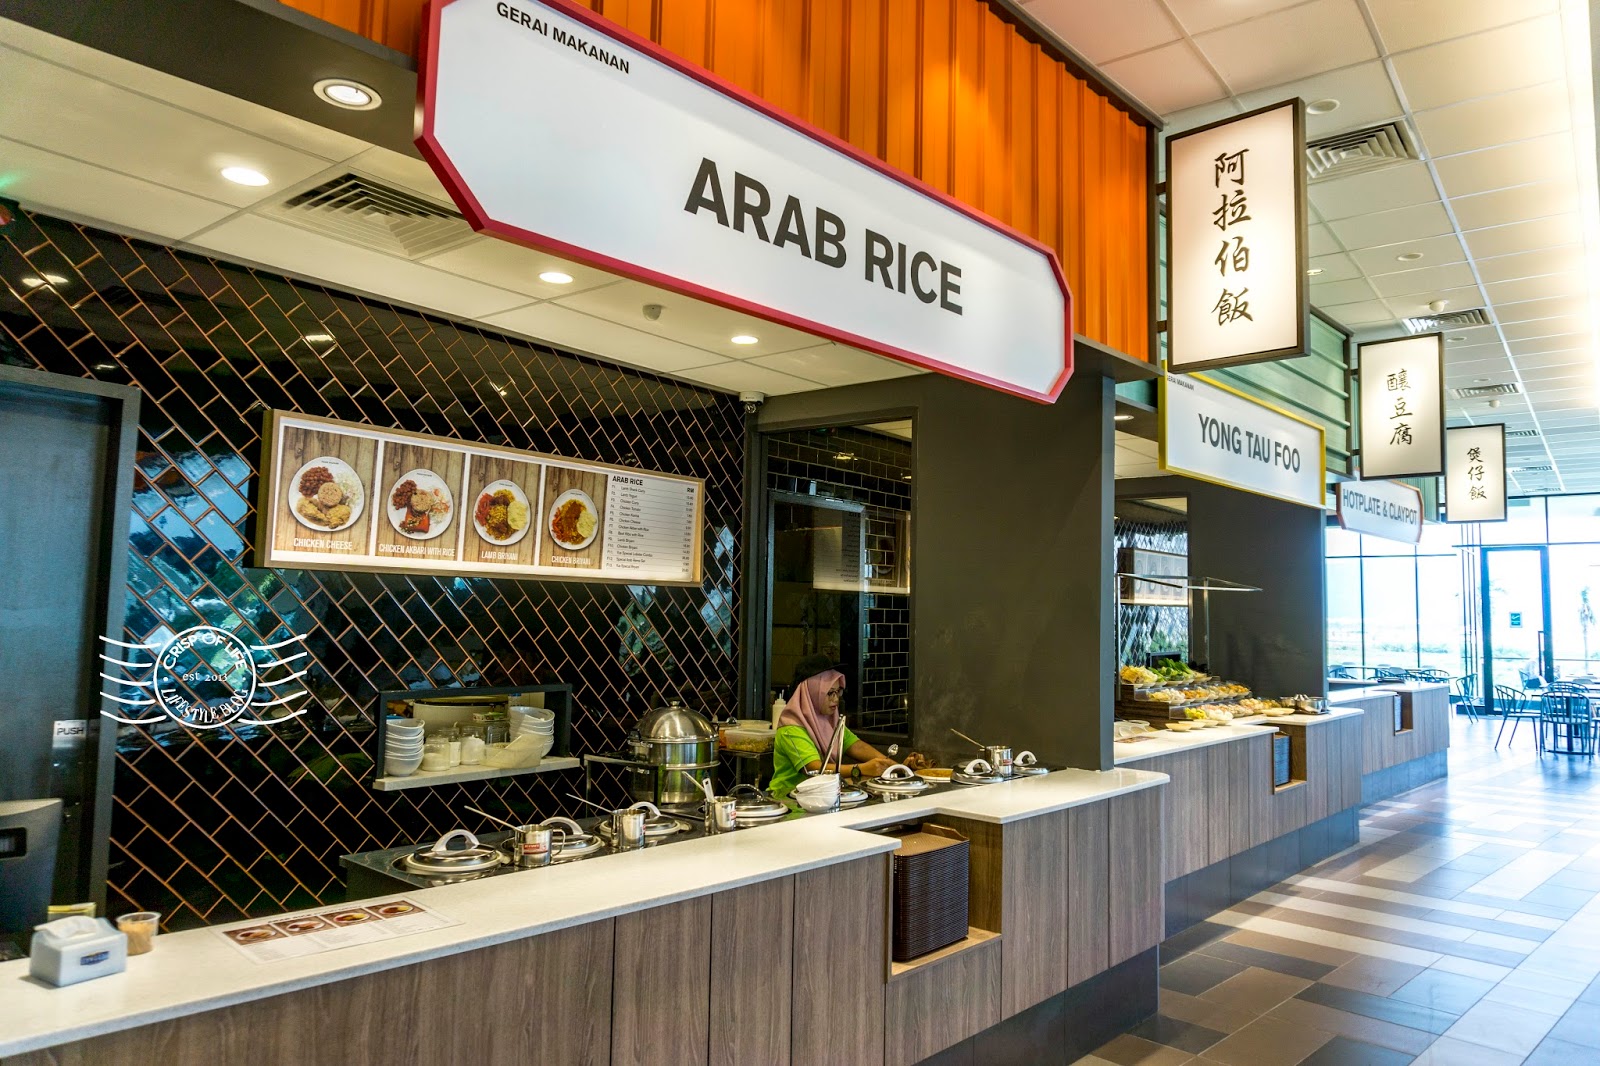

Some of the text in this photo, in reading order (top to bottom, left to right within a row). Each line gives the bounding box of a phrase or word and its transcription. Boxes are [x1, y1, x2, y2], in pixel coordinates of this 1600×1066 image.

[496, 1, 630, 74] GERAI MAKANAN
[684, 157, 963, 316] ARAB RICE
[1212, 148, 1253, 326] 阿拉伯飯
[1198, 413, 1301, 474] YONG TAU FOO
[612, 476, 644, 486] ARAB RICE
[1343, 488, 1417, 526] HOTPLATE & CLAYPOT
[293, 537, 353, 550] CHICKEN CHEESE
[378, 543, 405, 553] CHICKEN
[427, 547, 442, 556] WITH
[441, 548, 456, 557] RICE
[481, 551, 497, 559] LAMB
[551, 556, 573, 564] CHICKEN
[56, 726, 85, 736] PUSH
